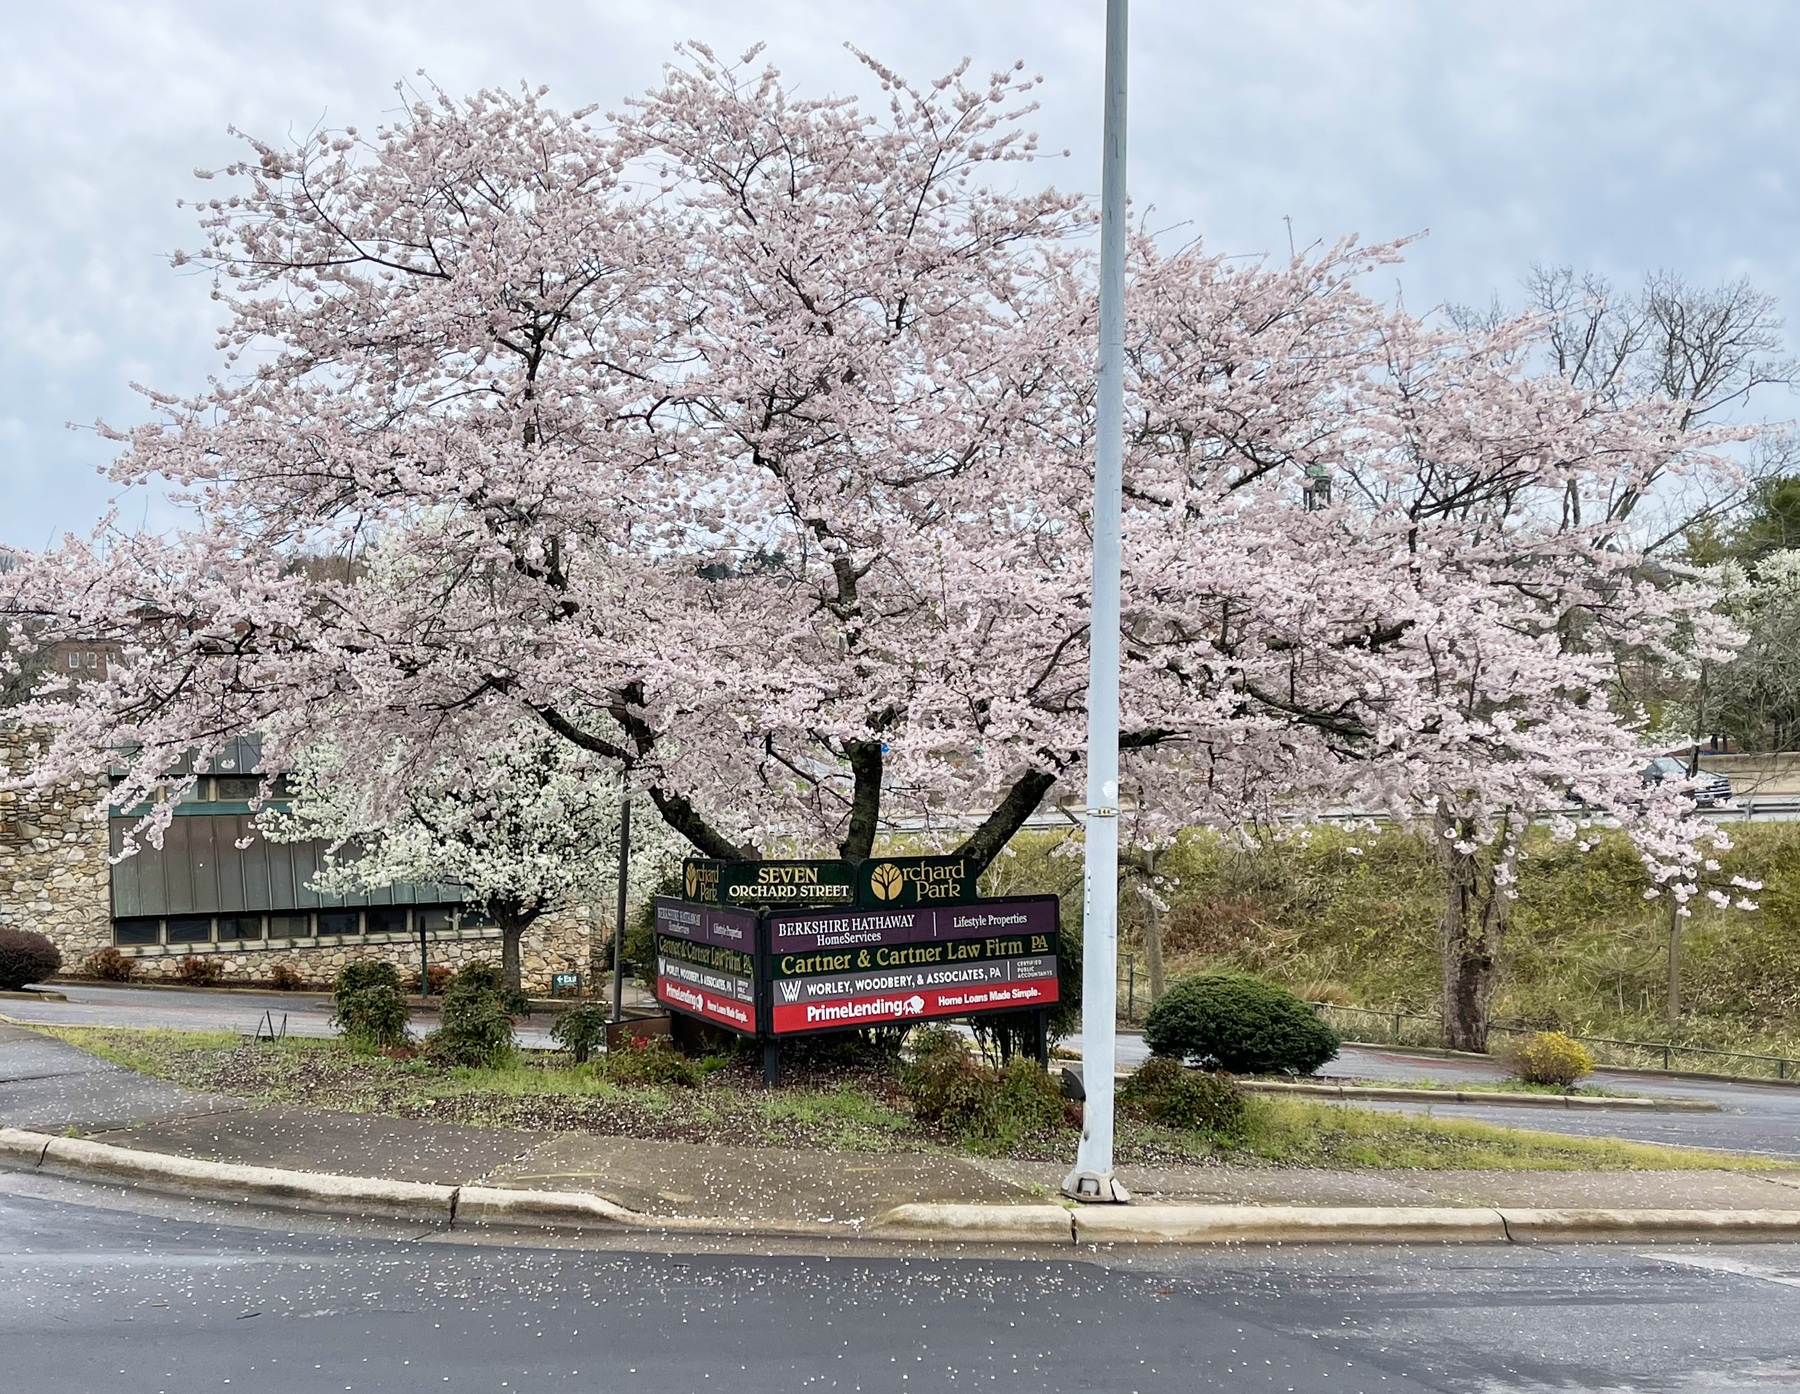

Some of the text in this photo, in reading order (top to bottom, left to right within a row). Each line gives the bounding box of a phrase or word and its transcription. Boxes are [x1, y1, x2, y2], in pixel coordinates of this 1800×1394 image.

[758, 867, 819, 884] SEVEN
[700, 882, 718, 902] Park
[729, 884, 850, 898] ORCHARD STREET
[915, 879, 961, 902] Park
[778, 914, 916, 937] BERKSHIRE HATHAWAY
[953, 912, 1028, 929] Lifestyle Properties
[816, 931, 882, 946] HomeServices
[781, 935, 1048, 975] Cartner & Cartner Law Firm PA
[806, 967, 1002, 996] WORLEY, WOODBERY, & ASSOCIATES, PA
[938, 996, 963, 1007] Home
[964, 993, 988, 1004] Loans
[989, 989, 1011, 1001] Made
[806, 998, 903, 1022] PrimeLending
